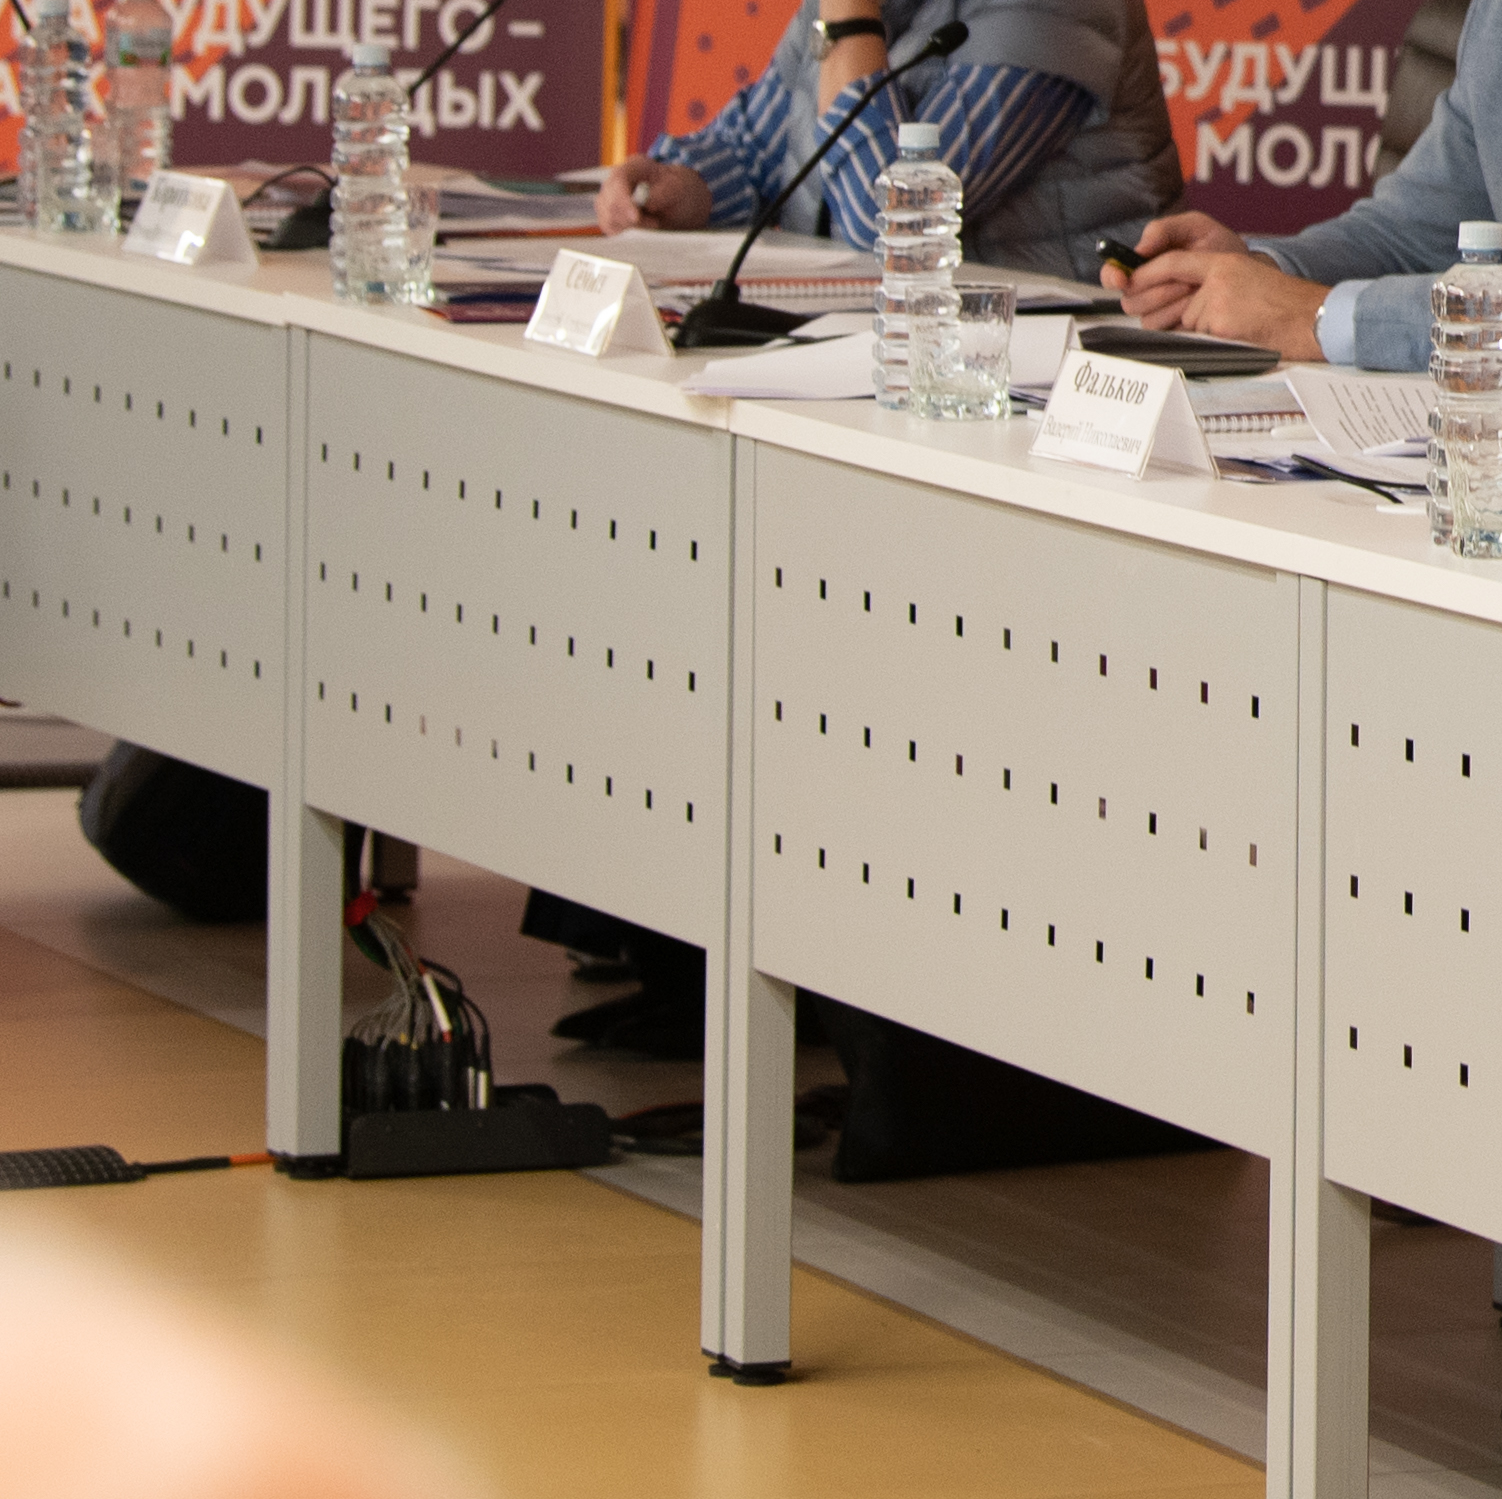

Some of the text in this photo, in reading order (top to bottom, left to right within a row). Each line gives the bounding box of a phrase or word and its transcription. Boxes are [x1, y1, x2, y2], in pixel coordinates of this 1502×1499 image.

[170, 63, 544, 137] МОЛДЫХ
[1155, 39, 1398, 117] БУДУЩ
[1196, 122, 1381, 188] МОЛ
[1073, 361, 1149, 405] Фальков
